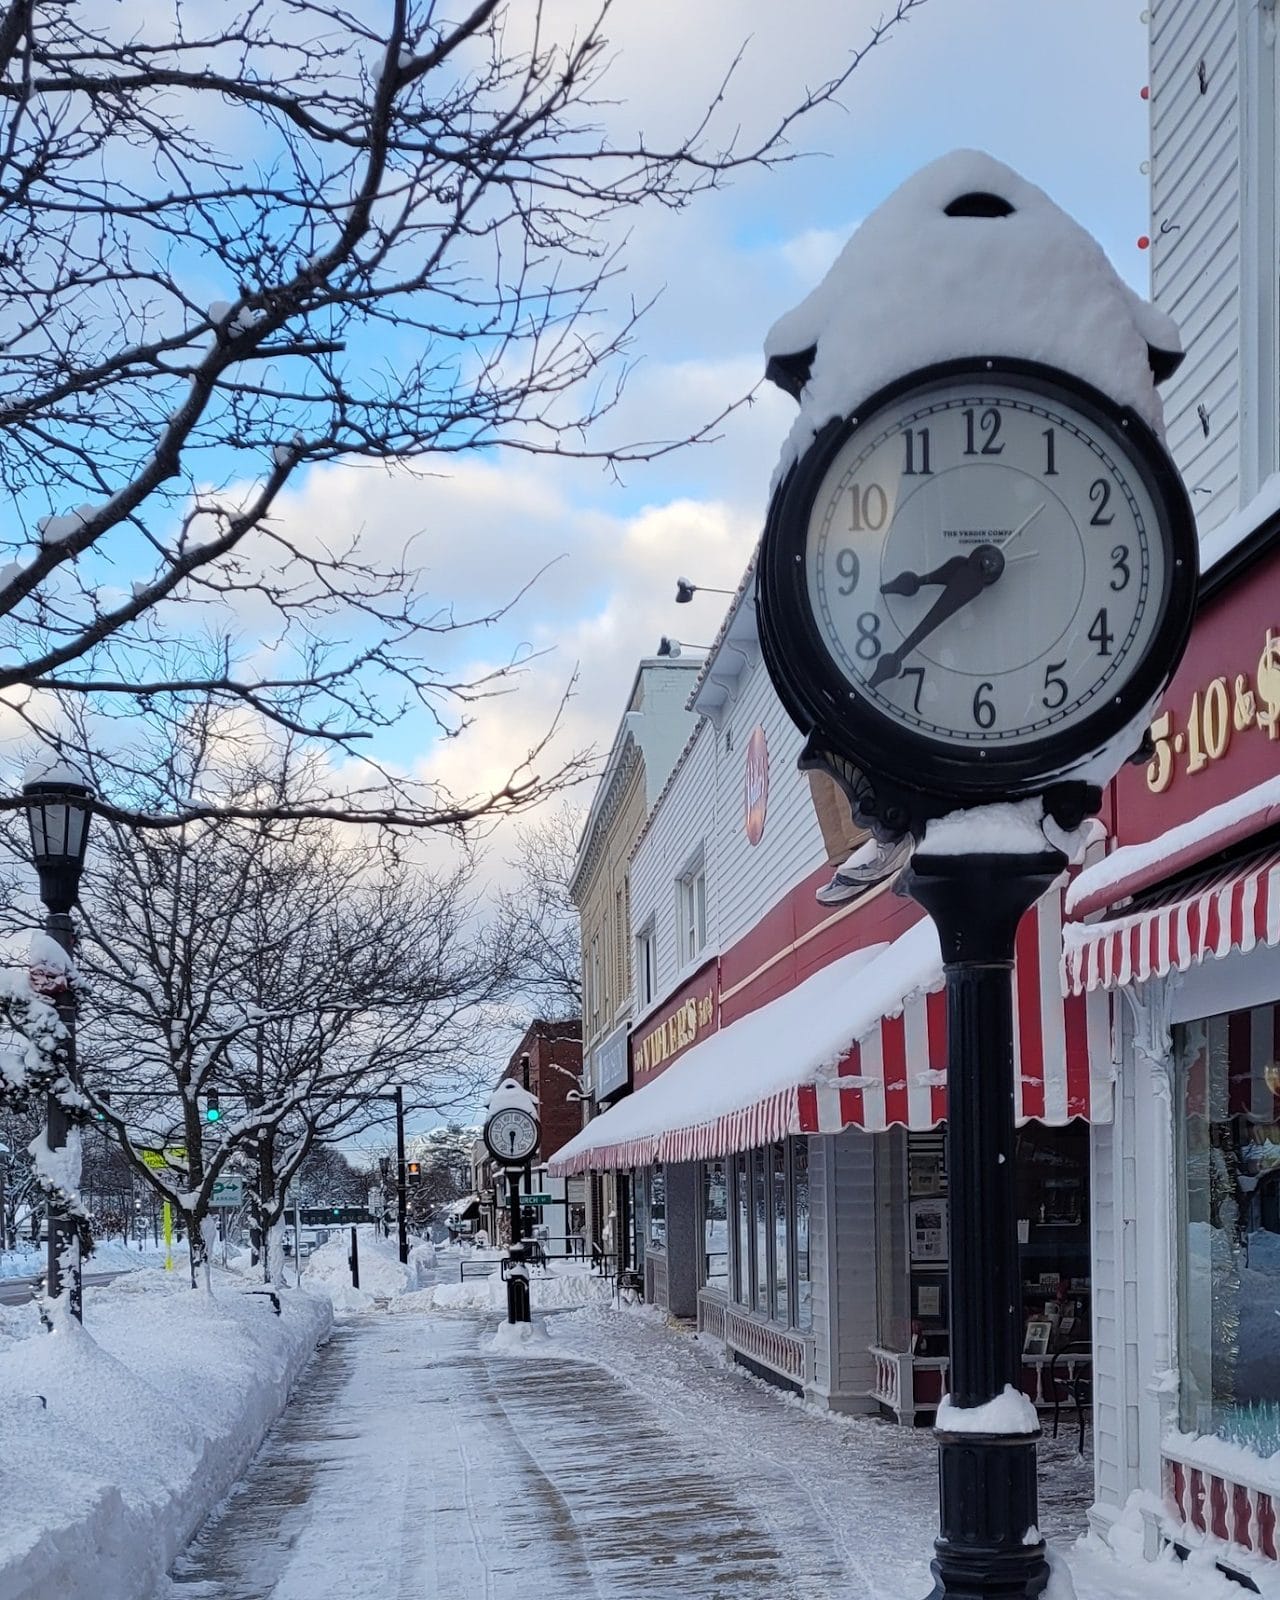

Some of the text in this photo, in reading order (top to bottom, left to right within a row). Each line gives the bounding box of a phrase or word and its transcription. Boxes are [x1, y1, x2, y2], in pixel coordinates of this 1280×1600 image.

[900, 428, 935, 476] 11
[962, 408, 1005, 455] 12
[1042, 428, 1060, 476] 1
[848, 484, 887, 531] 10
[1089, 478, 1115, 527] 2
[836, 548, 860, 596] 9
[1110, 544, 1131, 592] 3
[855, 612, 882, 660] 8
[1087, 607, 1114, 656] 4
[897, 667, 926, 715] 7
[972, 682, 996, 729] 6
[1042, 658, 1069, 709] 5
